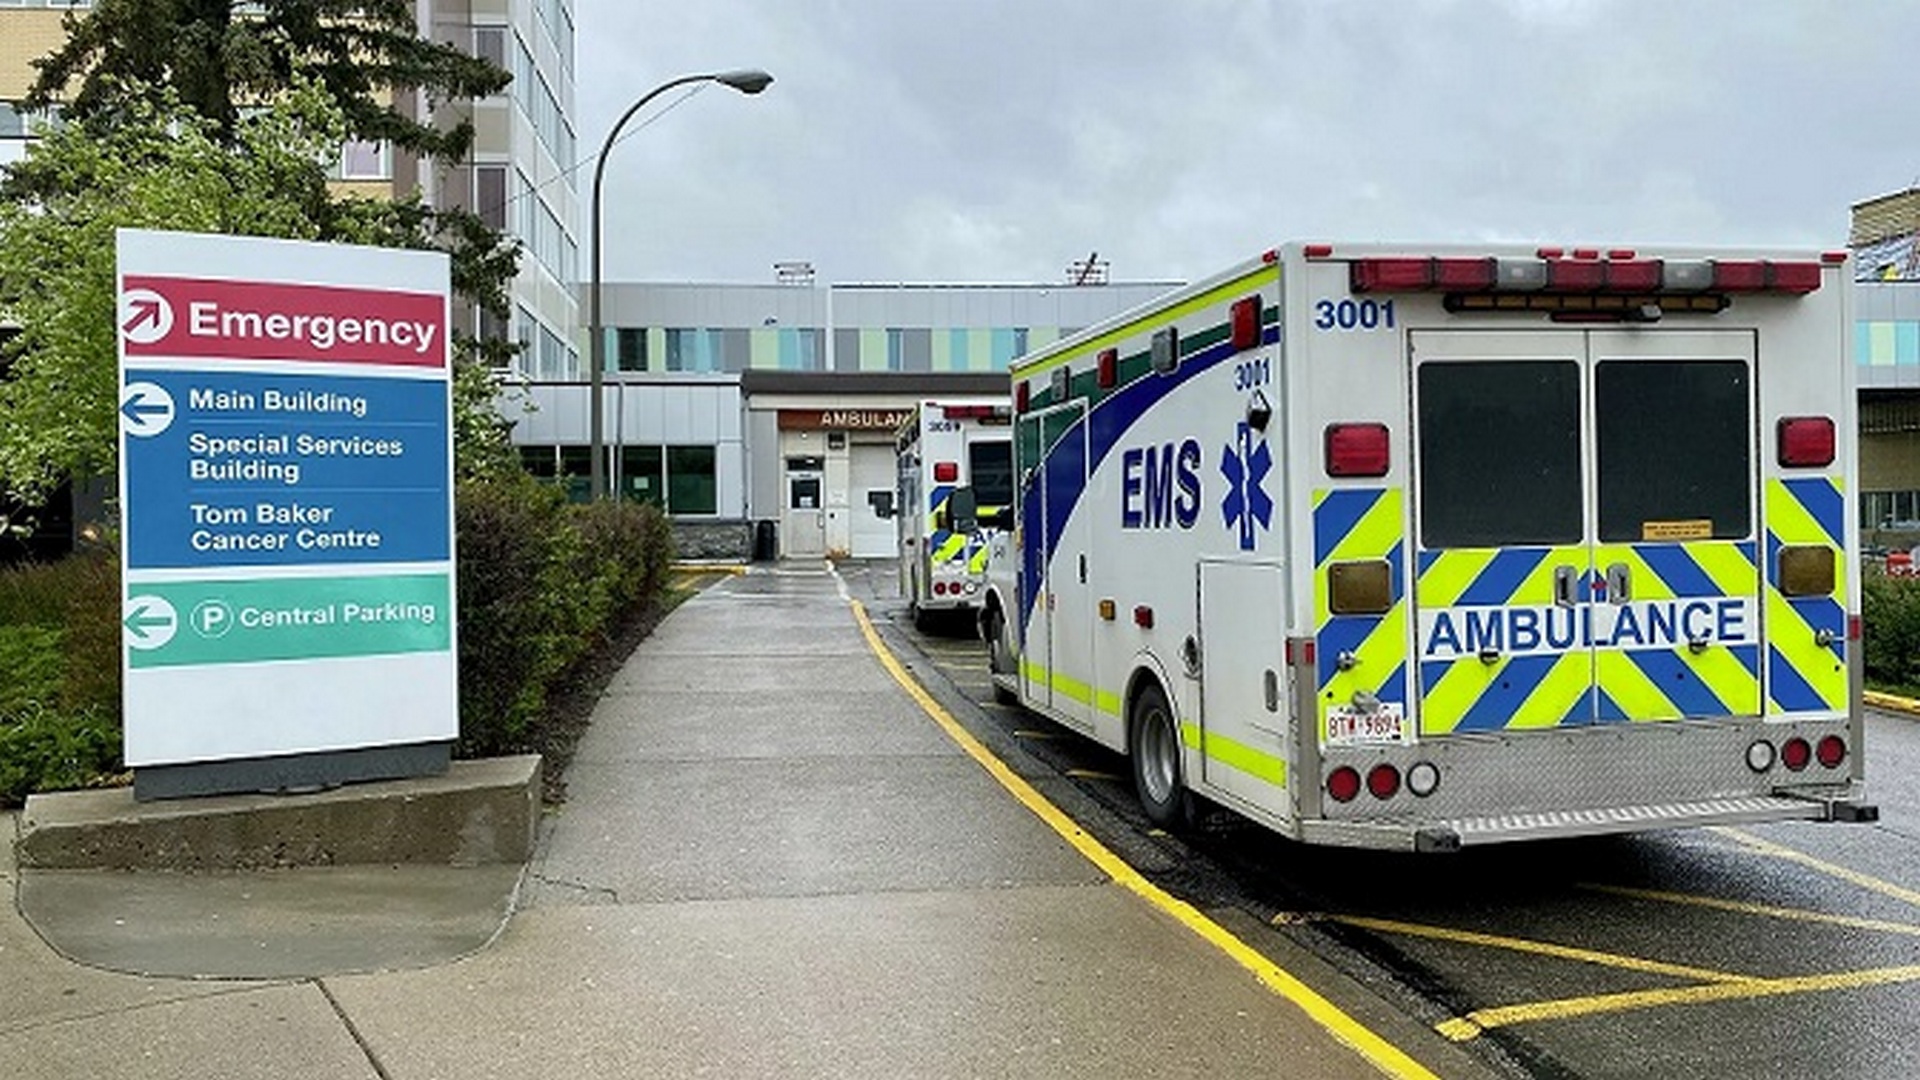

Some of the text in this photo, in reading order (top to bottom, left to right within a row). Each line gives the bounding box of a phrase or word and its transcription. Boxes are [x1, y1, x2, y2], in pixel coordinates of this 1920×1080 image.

[189, 302, 435, 353] Emergency
[1315, 299, 1396, 330] 3001
[189, 388, 367, 418] Main Building
[189, 433, 404, 458] Special Services
[190, 459, 300, 484] Building
[1122, 439, 1202, 529] EMS
[190, 503, 333, 524] Tom Baker
[191, 529, 381, 551] Cancer Centre
[240, 605, 335, 628] Central
[343, 603, 436, 624] Parking
[1425, 600, 1745, 655] AMBULANCE
